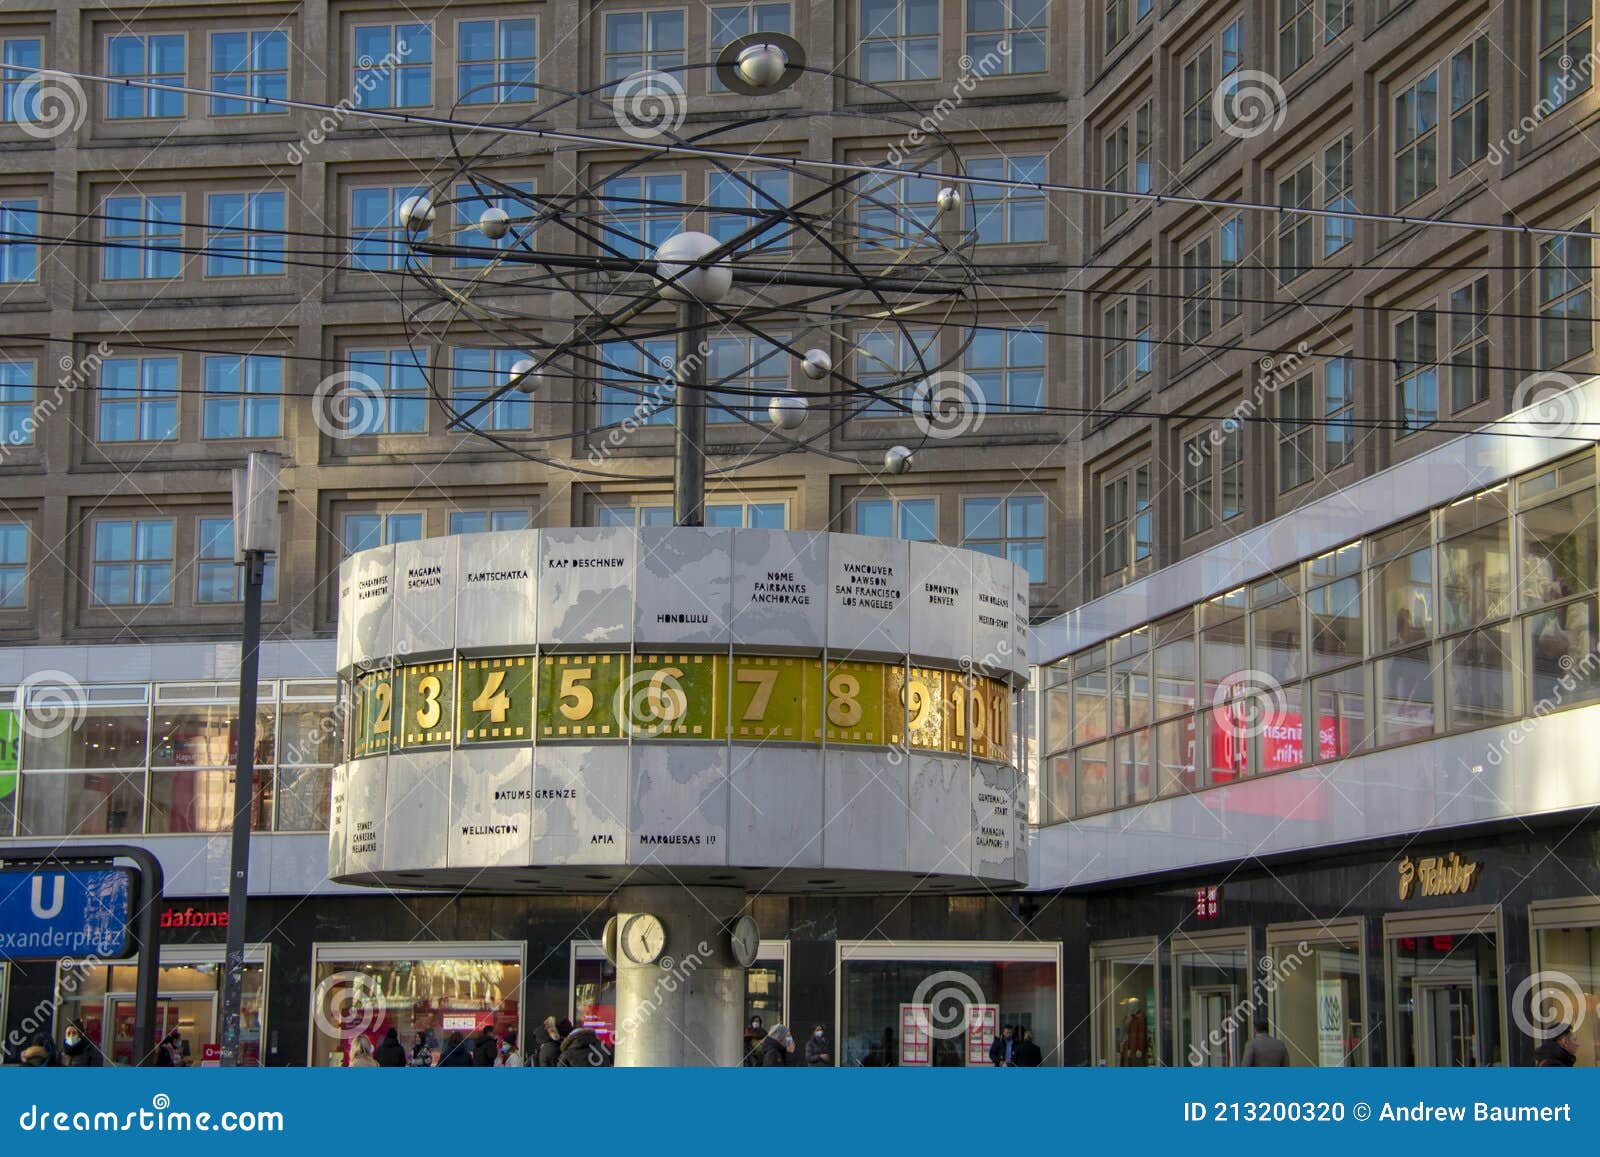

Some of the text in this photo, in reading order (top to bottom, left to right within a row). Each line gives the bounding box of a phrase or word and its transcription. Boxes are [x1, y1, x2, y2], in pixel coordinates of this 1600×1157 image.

[549, 559, 625, 568] KAP DESCHNEW
[844, 563, 893, 576] VANCOUVER
[467, 570, 528, 582] KAMTSCHATKA
[767, 572, 794, 581] NOME
[851, 576, 887, 586] DAWSON
[408, 577, 441, 589] SACHALIN
[754, 583, 807, 593] FAIRBANKS
[835, 586, 901, 599] SAN FRANCISCO
[925, 583, 959, 596] EDMONTON
[751, 594, 810, 605] ANCHORAGE
[842, 598, 893, 610] LOS ANGELES
[929, 595, 955, 606] DENVER
[657, 614, 708, 623] HONOLULU
[472, 671, 510, 722] 4
[560, 668, 594, 720] 5
[648, 667, 687, 721] 6
[737, 669, 779, 721] 7
[827, 674, 862, 726] 8
[373, 683, 391, 733] 2
[416, 676, 441, 728] 3
[901, 680, 930, 731] 9
[952, 686, 985, 740] 10
[993, 694, 1008, 747] 11
[495, 789, 577, 800] DATUMS GRENZE
[462, 825, 518, 835] WELLINGTON
[591, 834, 614, 844] APIA
[640, 835, 701, 845] MARQUESAS
[31, 876, 65, 919] U
